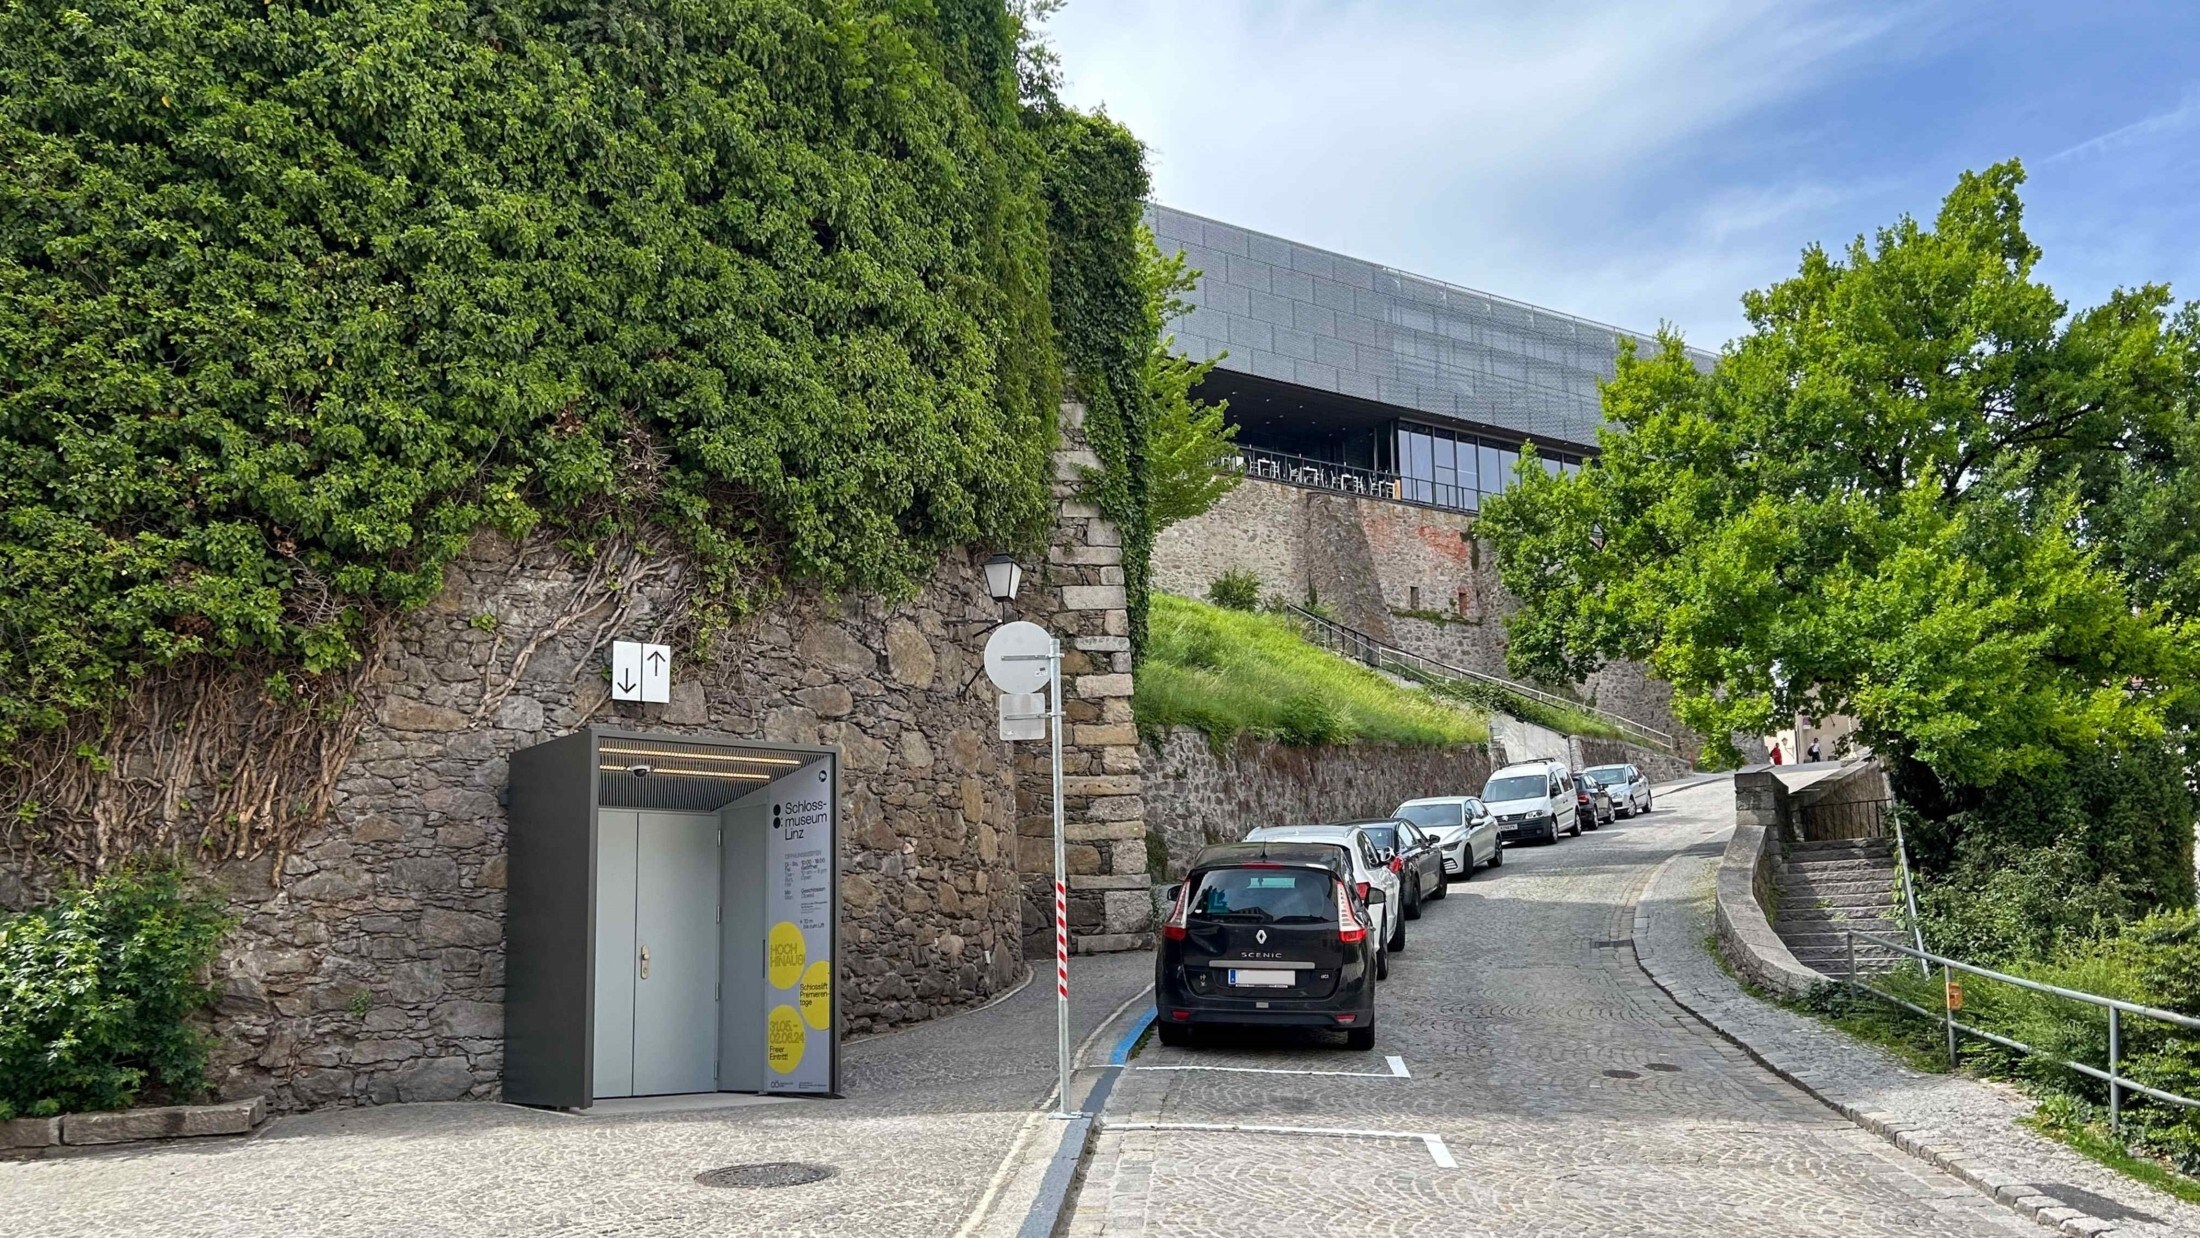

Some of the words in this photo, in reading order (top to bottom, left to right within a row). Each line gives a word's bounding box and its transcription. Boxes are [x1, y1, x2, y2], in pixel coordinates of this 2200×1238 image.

[785, 800, 827, 814] Schloss-
[785, 813, 827, 827] museum
[785, 827, 804, 840] Linz
[770, 943, 797, 955] HOCH
